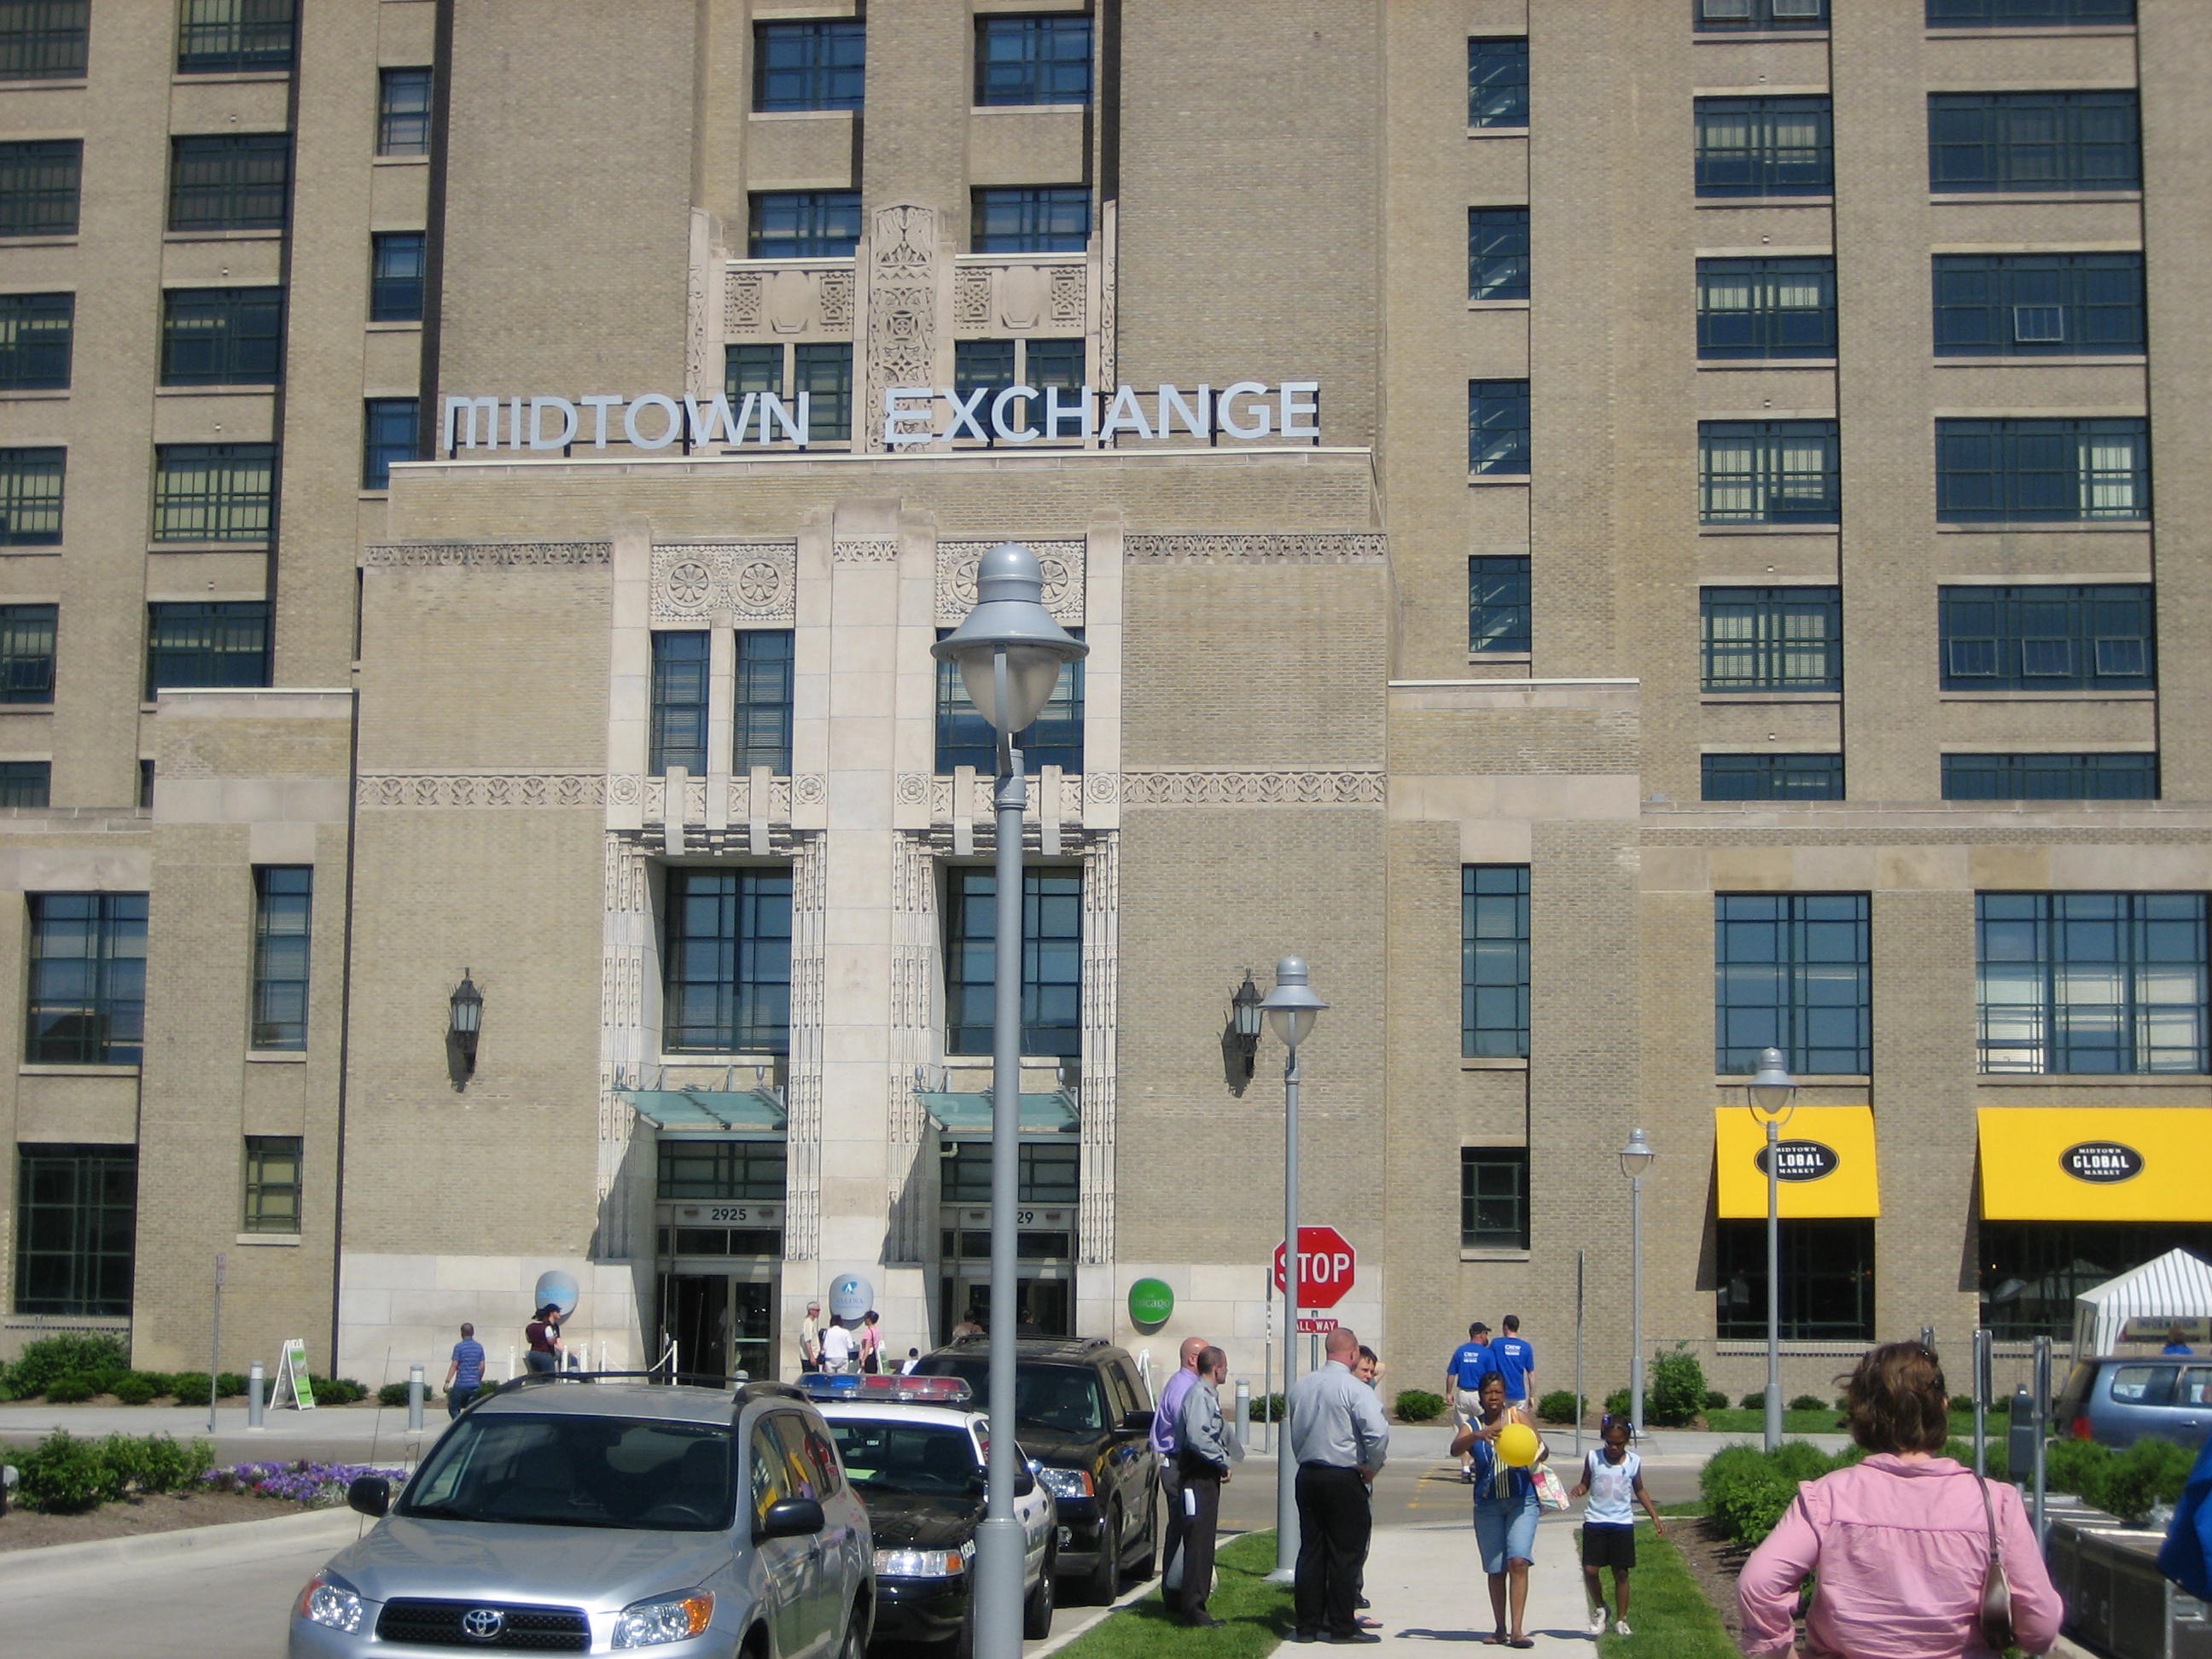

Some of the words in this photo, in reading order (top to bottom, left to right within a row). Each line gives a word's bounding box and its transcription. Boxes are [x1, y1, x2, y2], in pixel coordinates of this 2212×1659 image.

[444, 392, 810, 451] MIDTOWN
[883, 381, 1321, 444] EXCHANGE
[1778, 1154, 1825, 1167] LOBAL
[2072, 1155, 2130, 1168] GLOBAL
[711, 1208, 747, 1221] 2925
[1315, 1320, 1336, 1331] WAY
